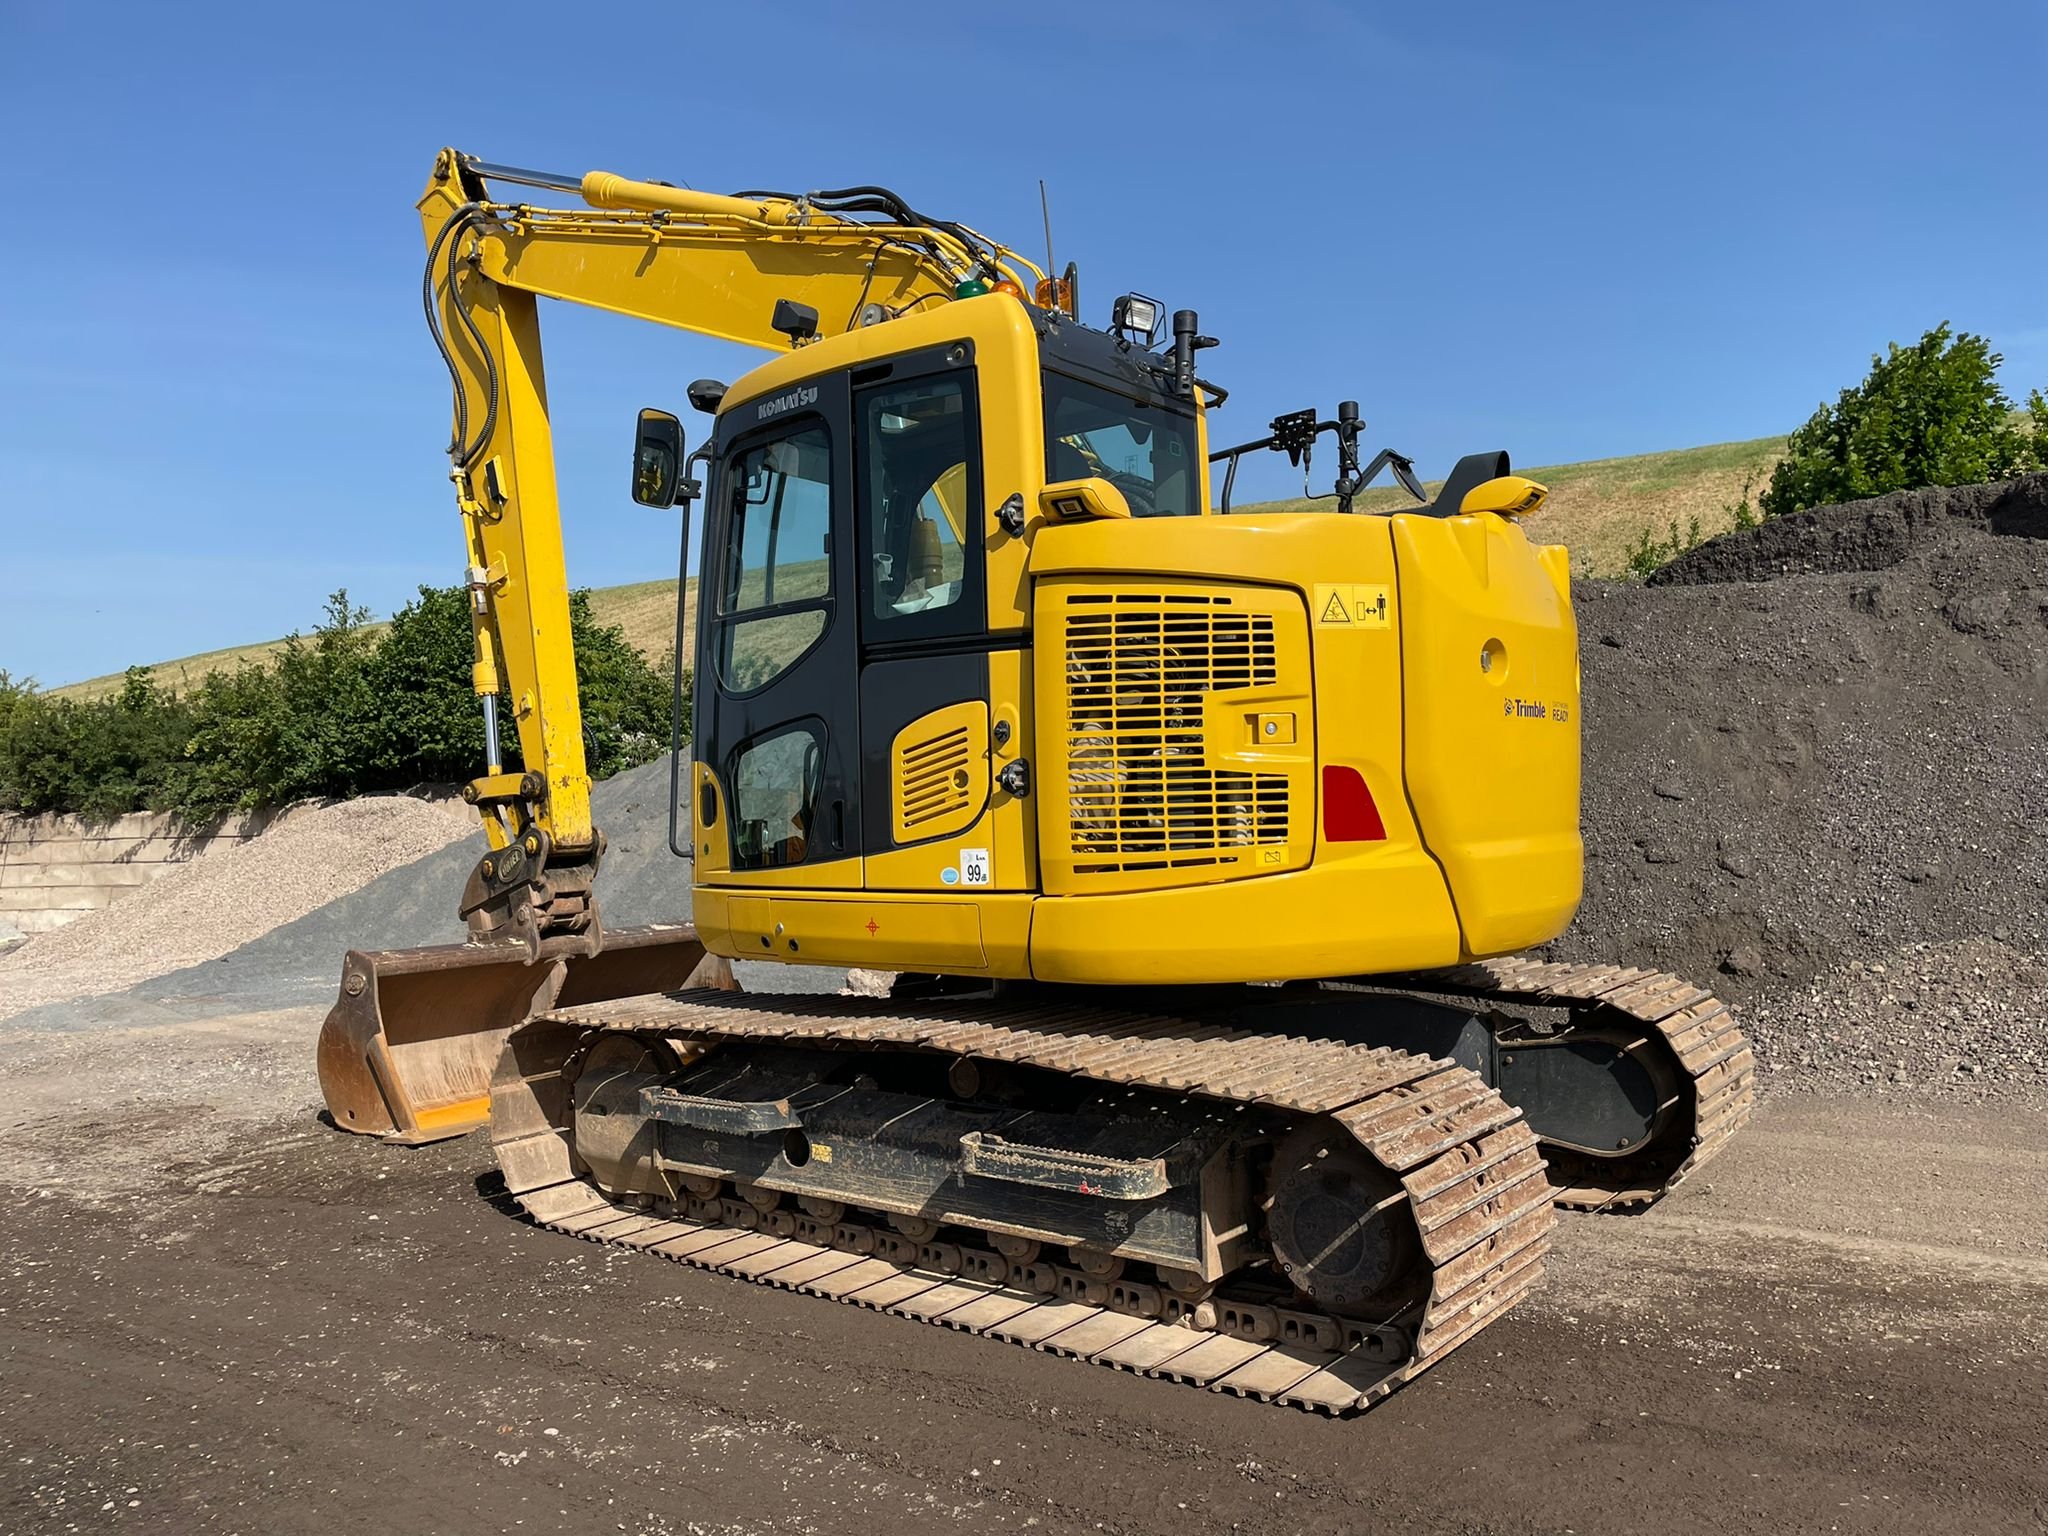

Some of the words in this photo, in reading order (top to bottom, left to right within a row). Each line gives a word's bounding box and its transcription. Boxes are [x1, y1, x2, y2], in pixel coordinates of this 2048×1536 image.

[758, 387, 818, 419] KOMATSU
[1515, 699, 1545, 718] Trimble
[967, 864, 981, 882] 99
